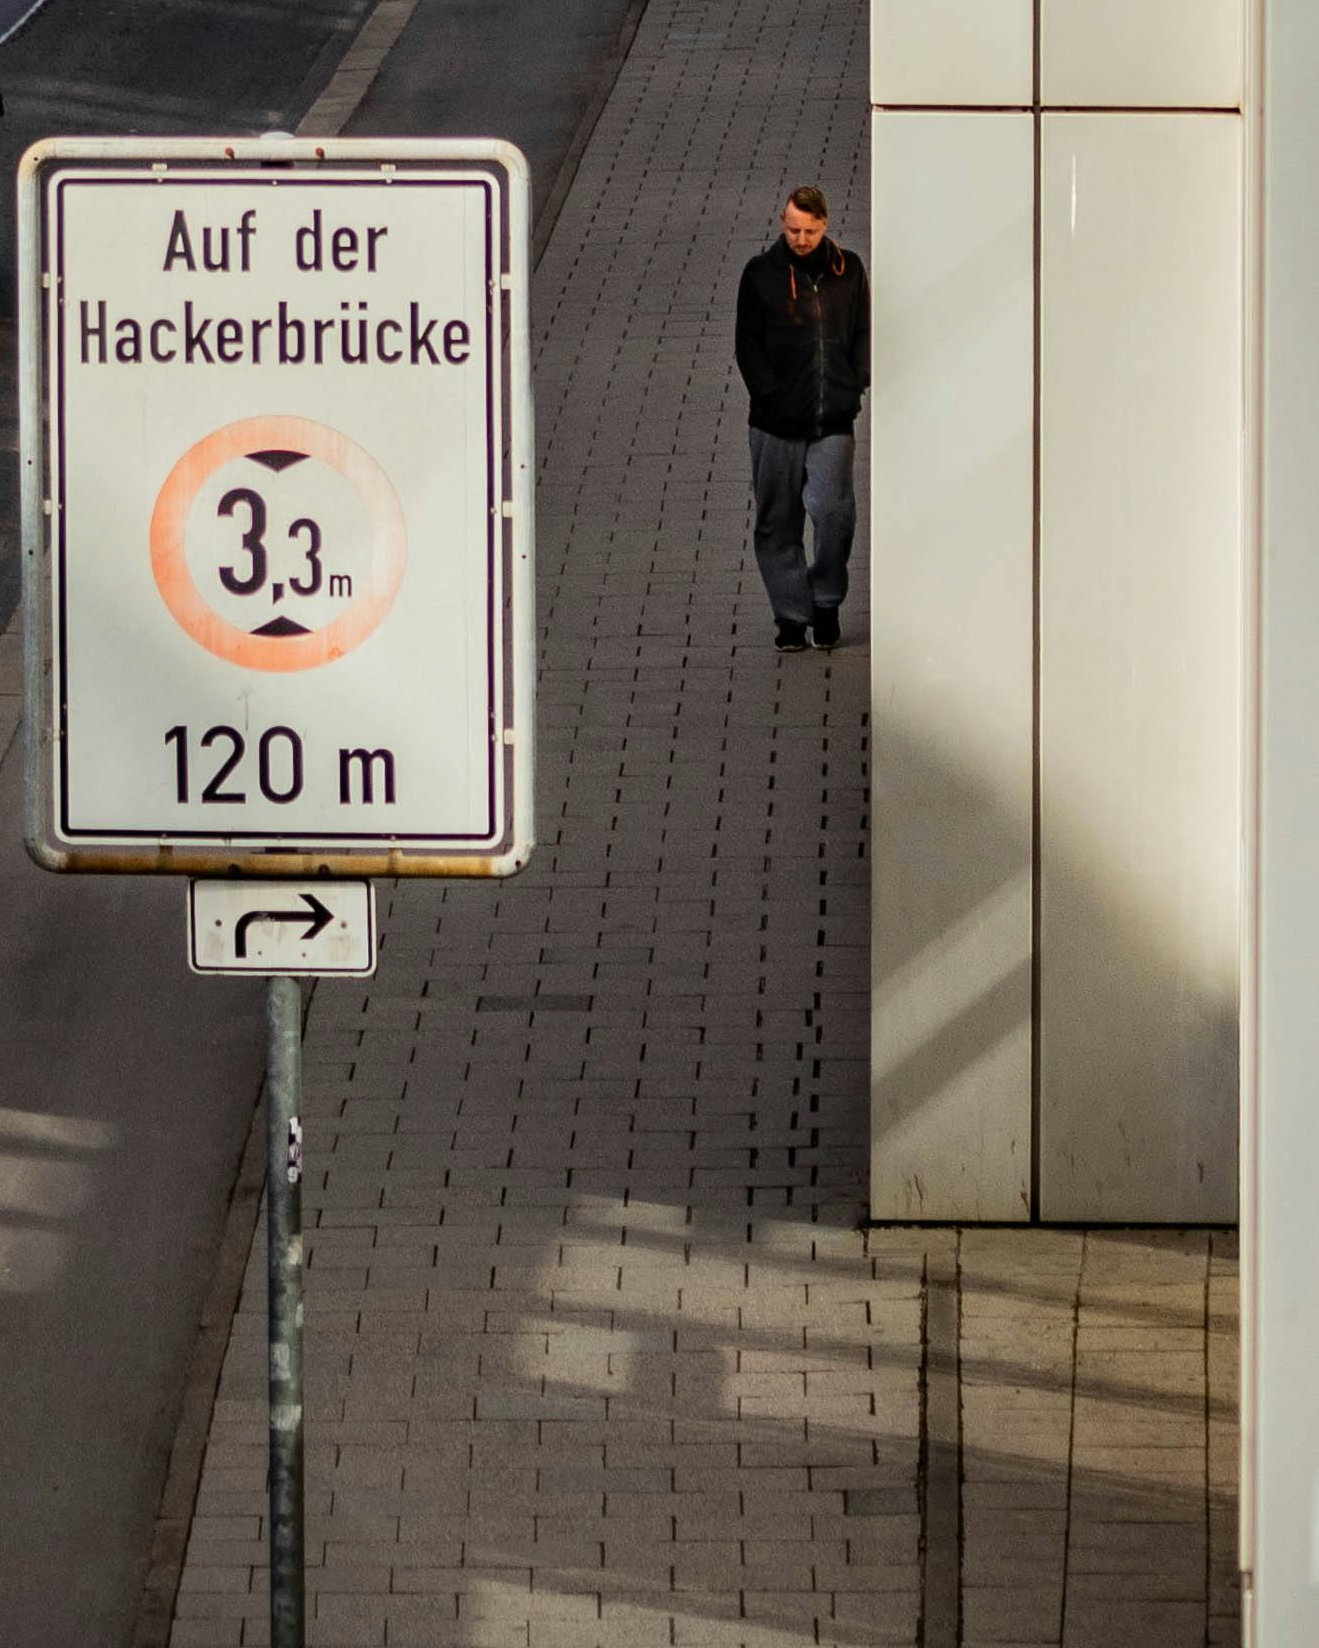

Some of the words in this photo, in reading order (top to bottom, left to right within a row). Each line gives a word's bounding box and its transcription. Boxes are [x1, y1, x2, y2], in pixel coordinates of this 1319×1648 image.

[163, 209, 256, 273] Auf
[294, 209, 389, 272] der
[79, 300, 472, 366] Hackerbrücke
[217, 487, 323, 605] 3,3
[329, 572, 353, 599] m
[164, 724, 305, 806] 120
[339, 747, 396, 805] m
